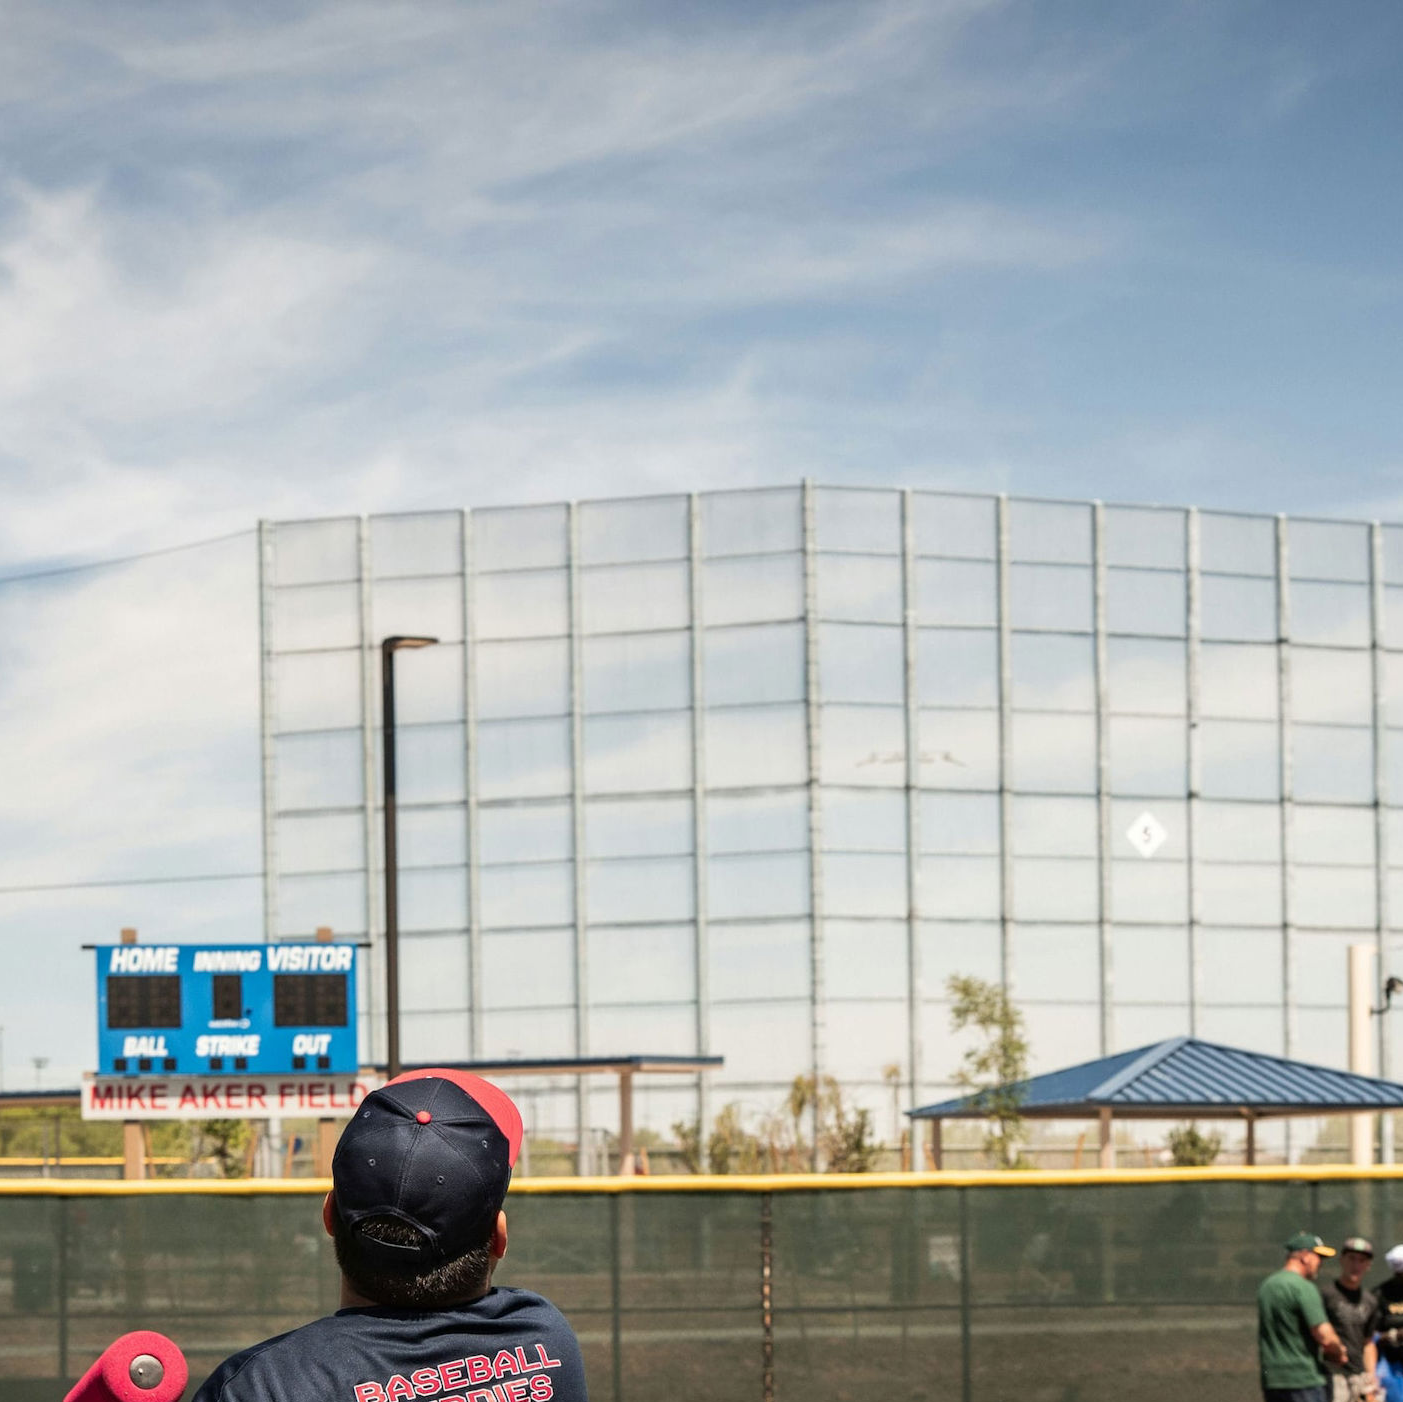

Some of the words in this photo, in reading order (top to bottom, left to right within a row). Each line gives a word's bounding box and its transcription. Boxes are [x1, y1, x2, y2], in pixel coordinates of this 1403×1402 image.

[110, 946, 180, 973] HOME
[193, 950, 263, 973] INNING
[266, 945, 354, 972] VISITOR
[123, 1036, 169, 1058] BALL
[195, 1034, 261, 1057] STRIKE
[292, 1033, 331, 1056] OUT
[90, 1083, 168, 1110] MIKE
[178, 1082, 267, 1110] AKER
[278, 1081, 367, 1109] FIELD
